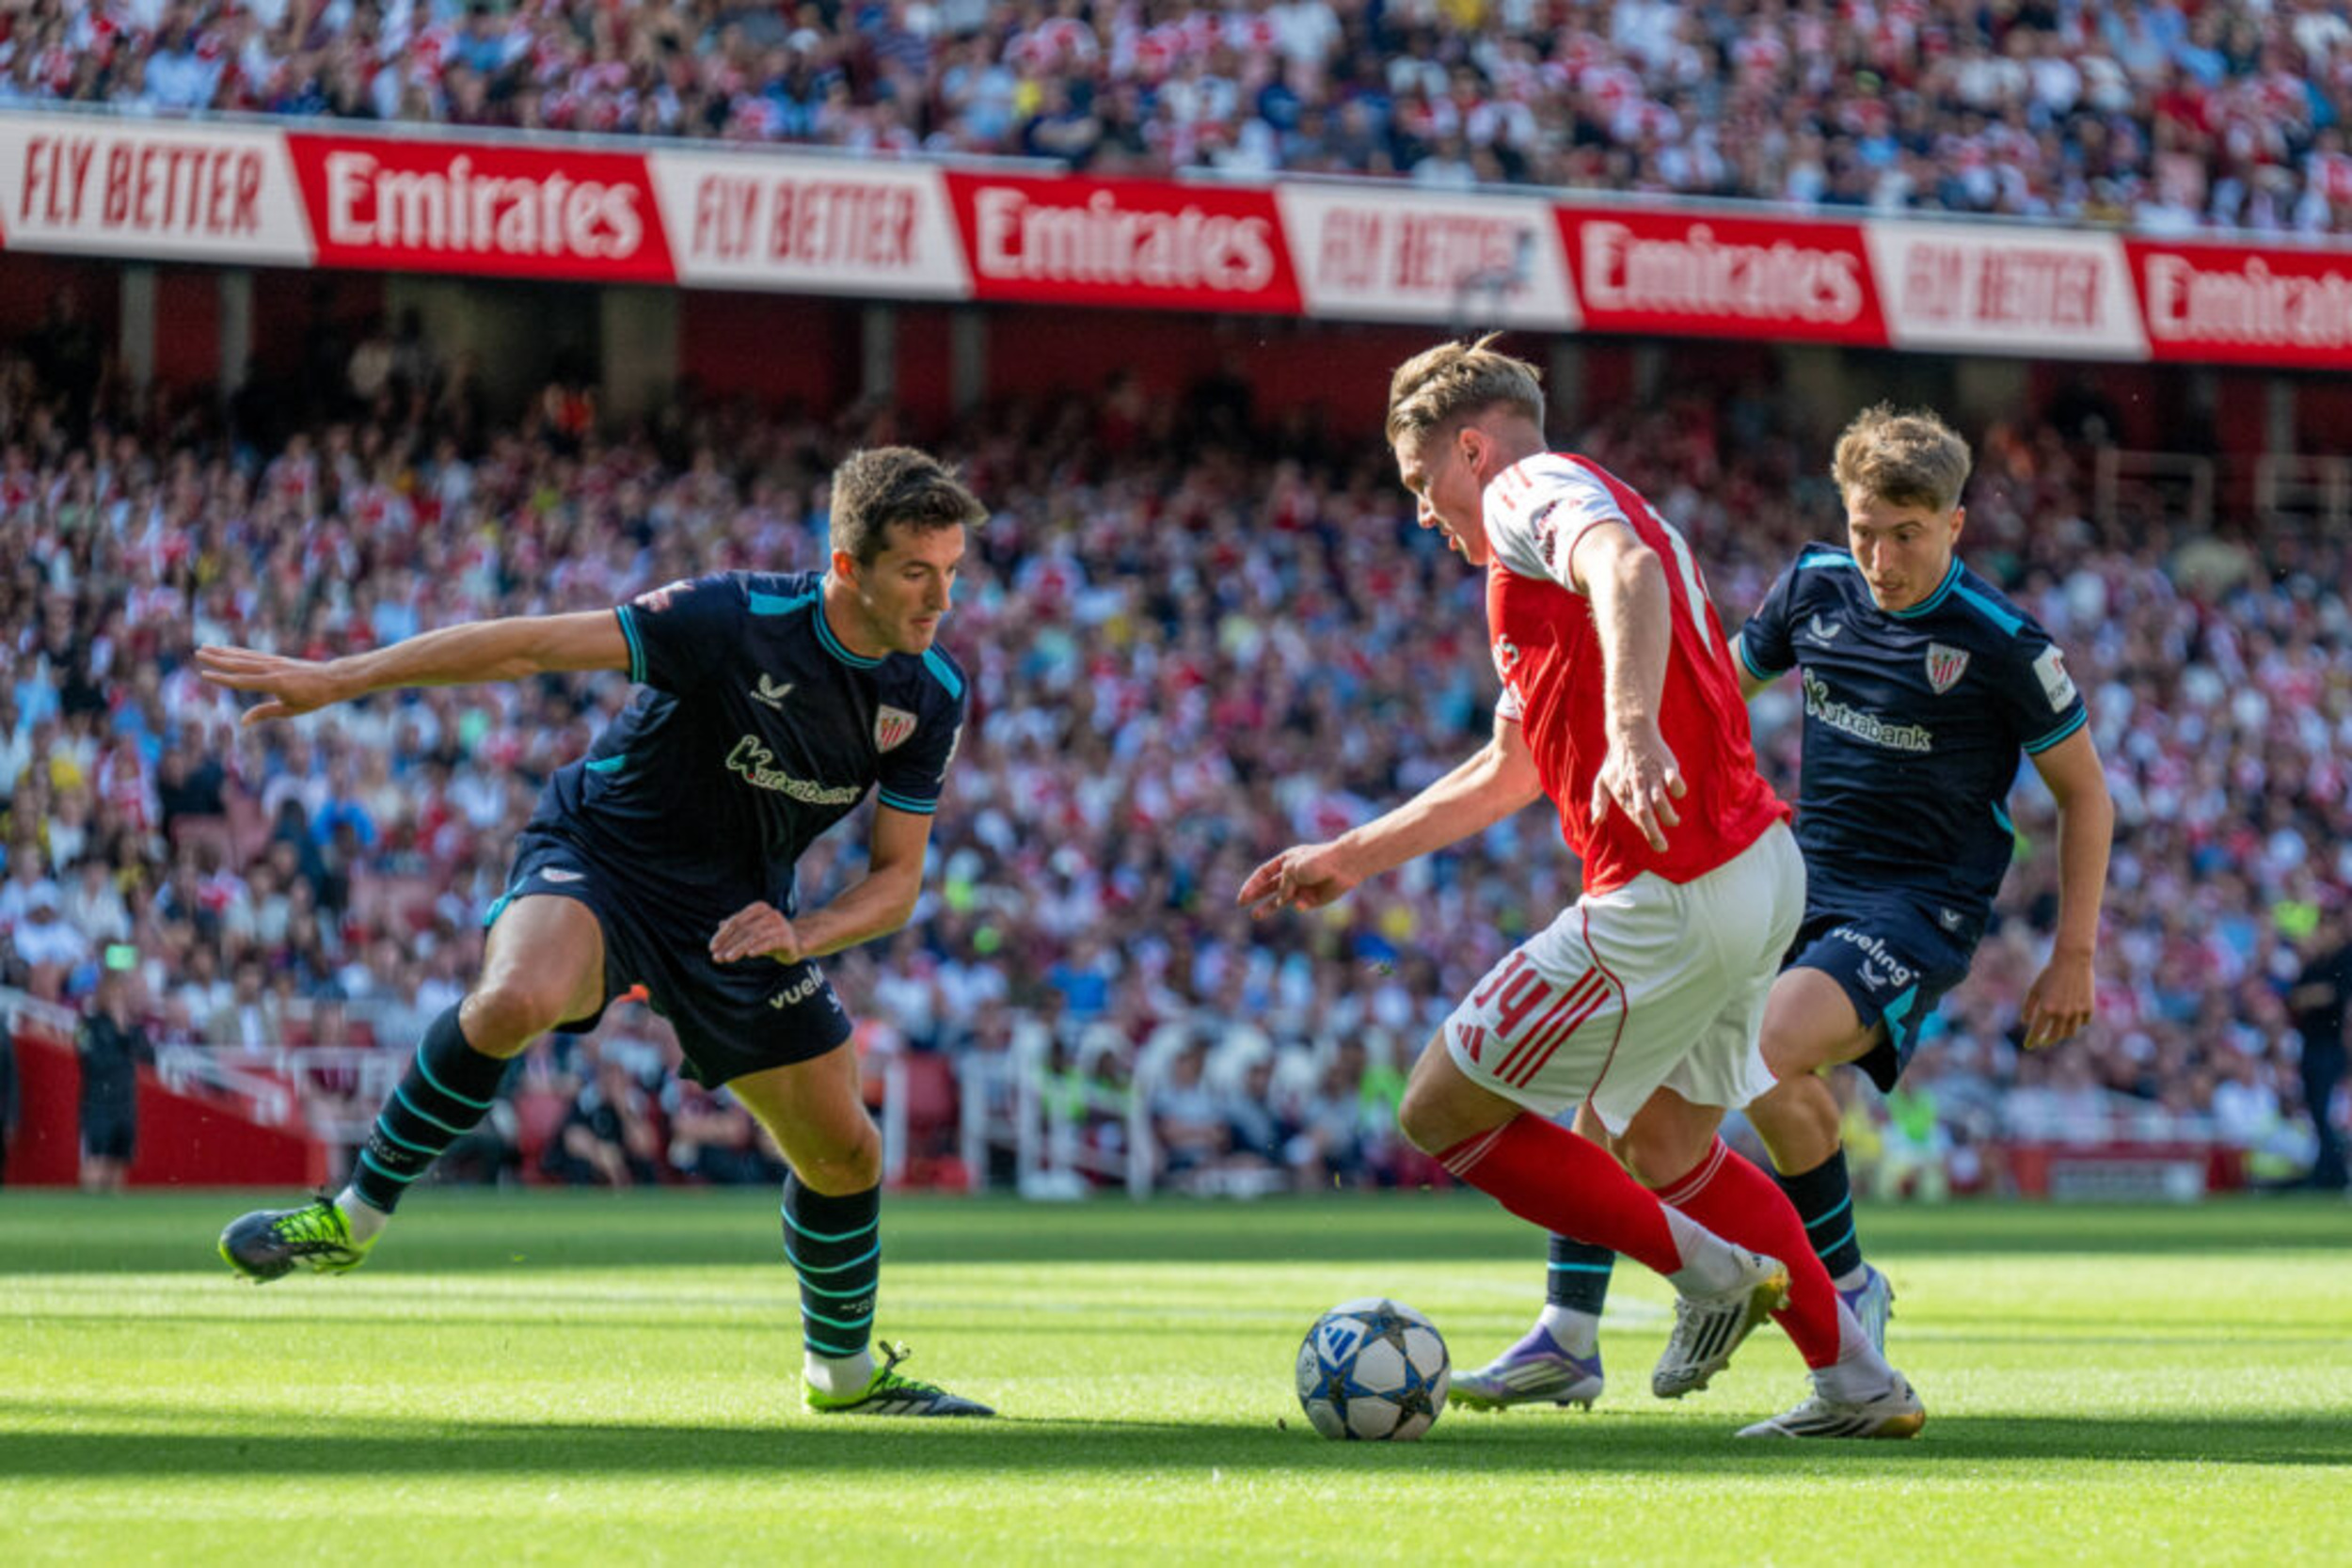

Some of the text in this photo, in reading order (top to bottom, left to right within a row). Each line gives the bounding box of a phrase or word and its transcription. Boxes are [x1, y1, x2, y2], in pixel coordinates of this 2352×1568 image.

[21, 135, 263, 233] FLY BETTER
[325, 150, 644, 260] Emirates
[694, 173, 919, 267] FLY BETTER
[976, 187, 1276, 291] Emirates
[1581, 222, 1863, 325] Emirates
[2146, 253, 2352, 347] Emirat
[1803, 667, 1931, 752] Kutxabank
[1473, 950, 1552, 1038] 14
[1831, 927, 1911, 987] vueling
